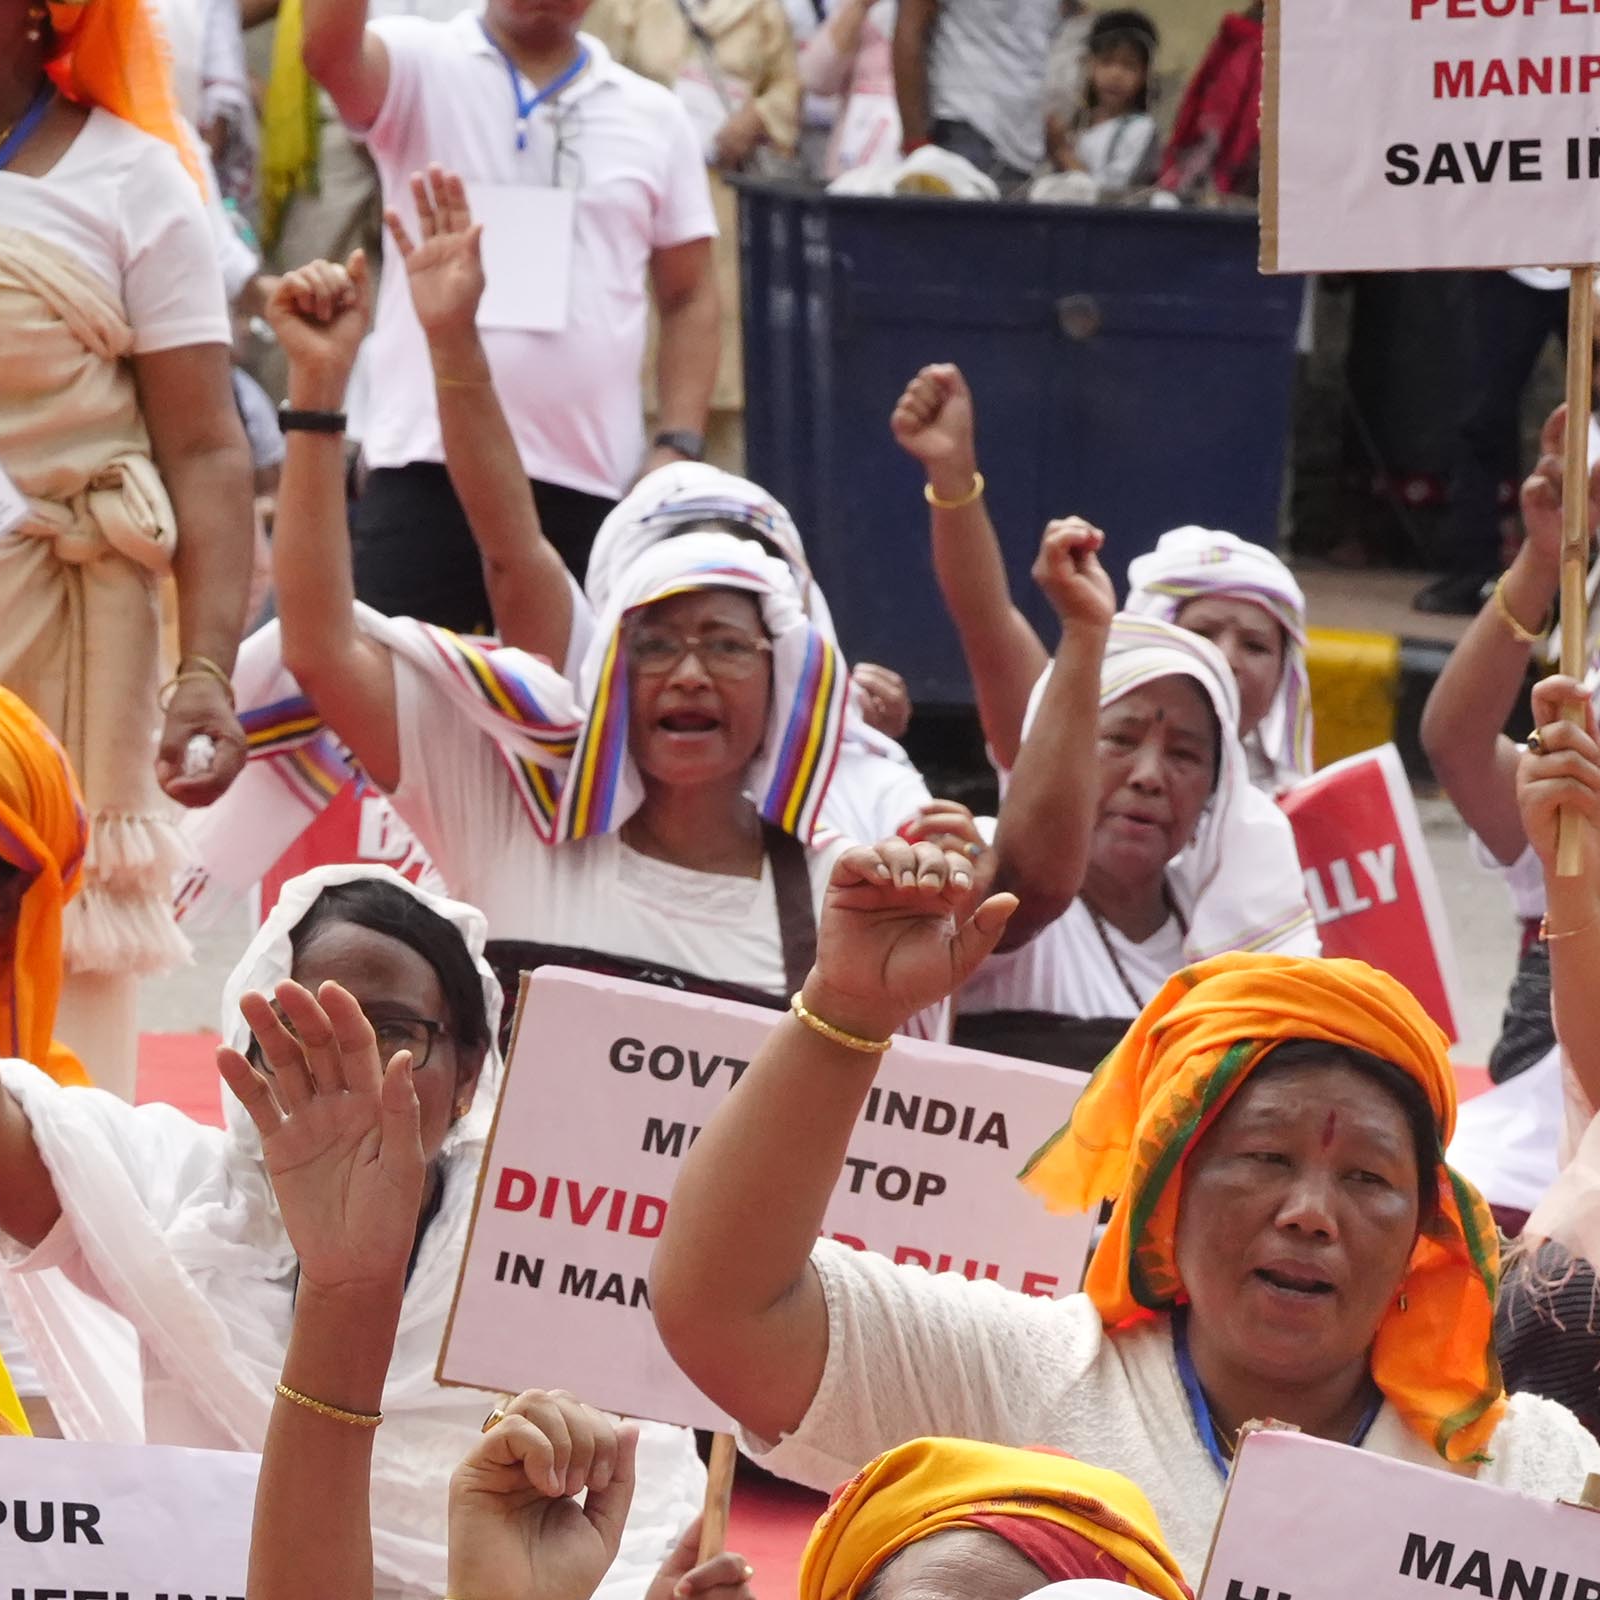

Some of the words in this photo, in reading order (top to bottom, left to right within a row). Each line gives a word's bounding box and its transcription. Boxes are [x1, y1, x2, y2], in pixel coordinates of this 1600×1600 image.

[1385, 139, 1542, 186] SAVE
[1303, 843, 1398, 926] LLY
[864, 1088, 1010, 1149] INDIA
[494, 1168, 667, 1239] DIVID
[846, 1156, 948, 1207] TOP
[495, 1251, 544, 1289] IN
